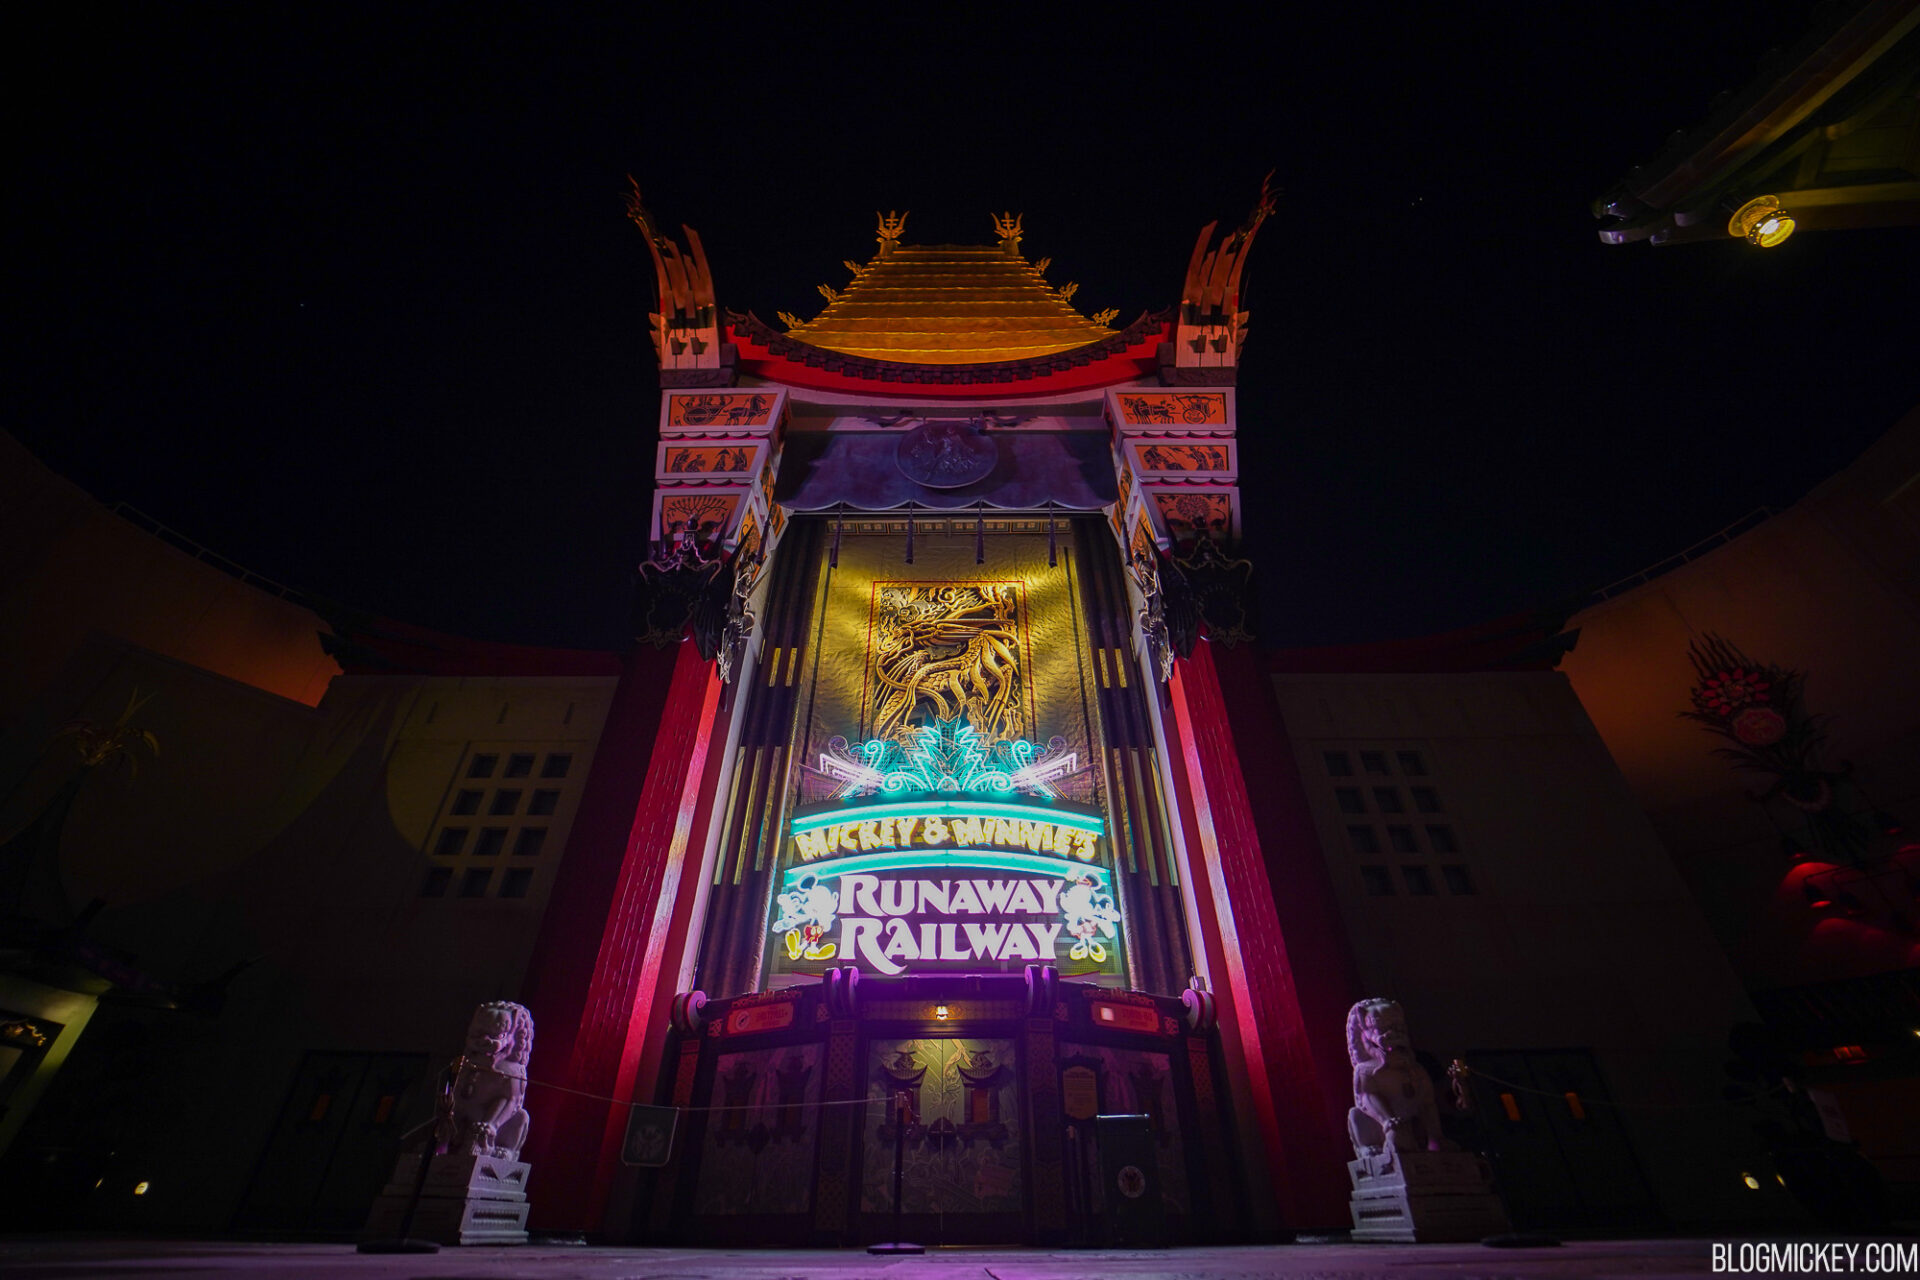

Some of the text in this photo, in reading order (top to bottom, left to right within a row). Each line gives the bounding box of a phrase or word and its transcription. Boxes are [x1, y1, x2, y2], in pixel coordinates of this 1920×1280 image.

[795, 817, 1098, 861] MICKEY & MINNIE'S
[837, 874, 1066, 916] RUNAWAY
[837, 918, 1063, 974] RAILWAY
